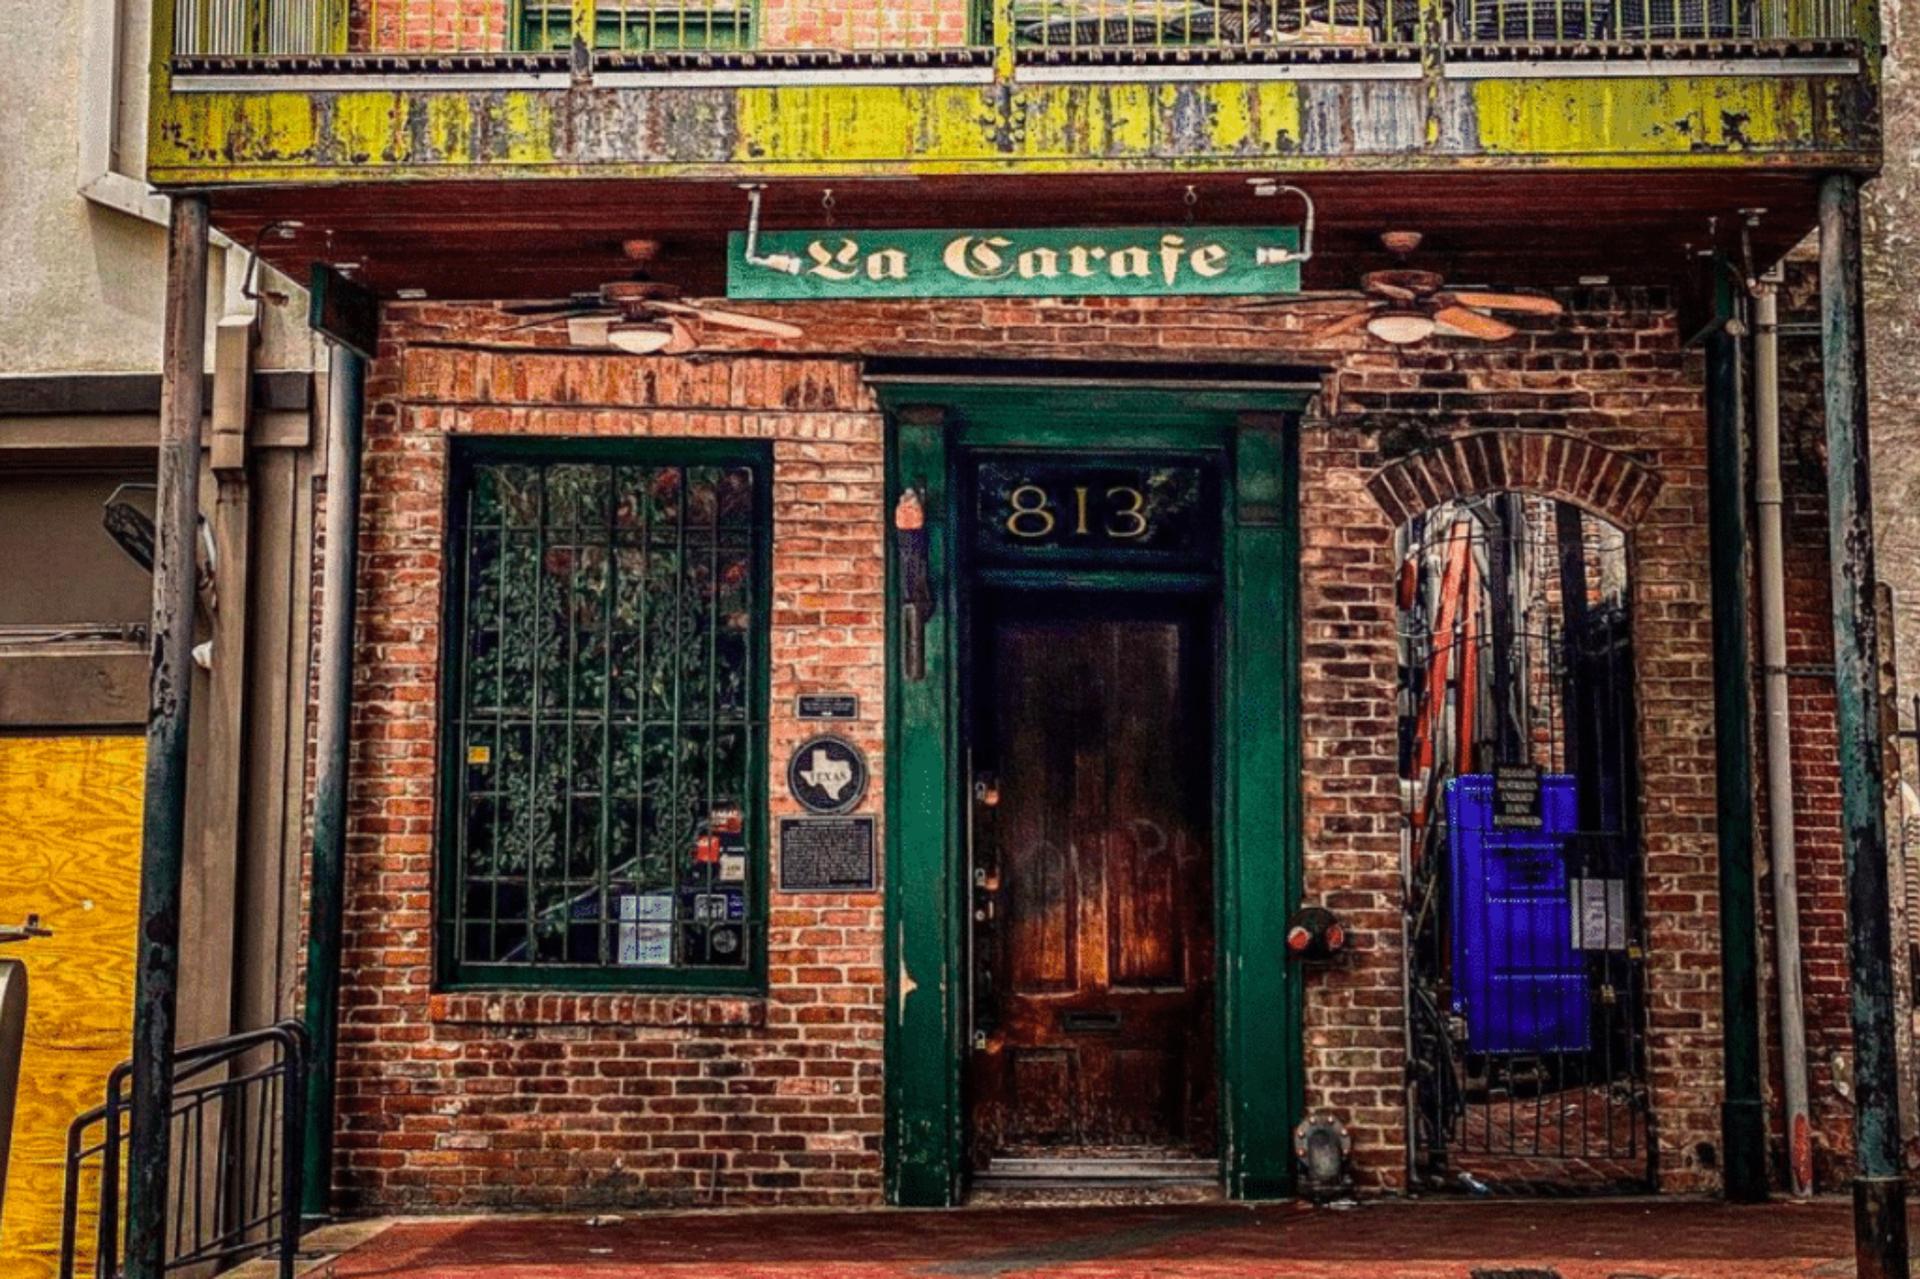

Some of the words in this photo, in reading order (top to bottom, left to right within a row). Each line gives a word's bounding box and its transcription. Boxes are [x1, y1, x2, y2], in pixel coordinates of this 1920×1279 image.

[807, 238, 908, 280] La
[943, 235, 1227, 287] Carafe
[1006, 485, 1148, 537] 813
[809, 770, 847, 783] TEXAS
